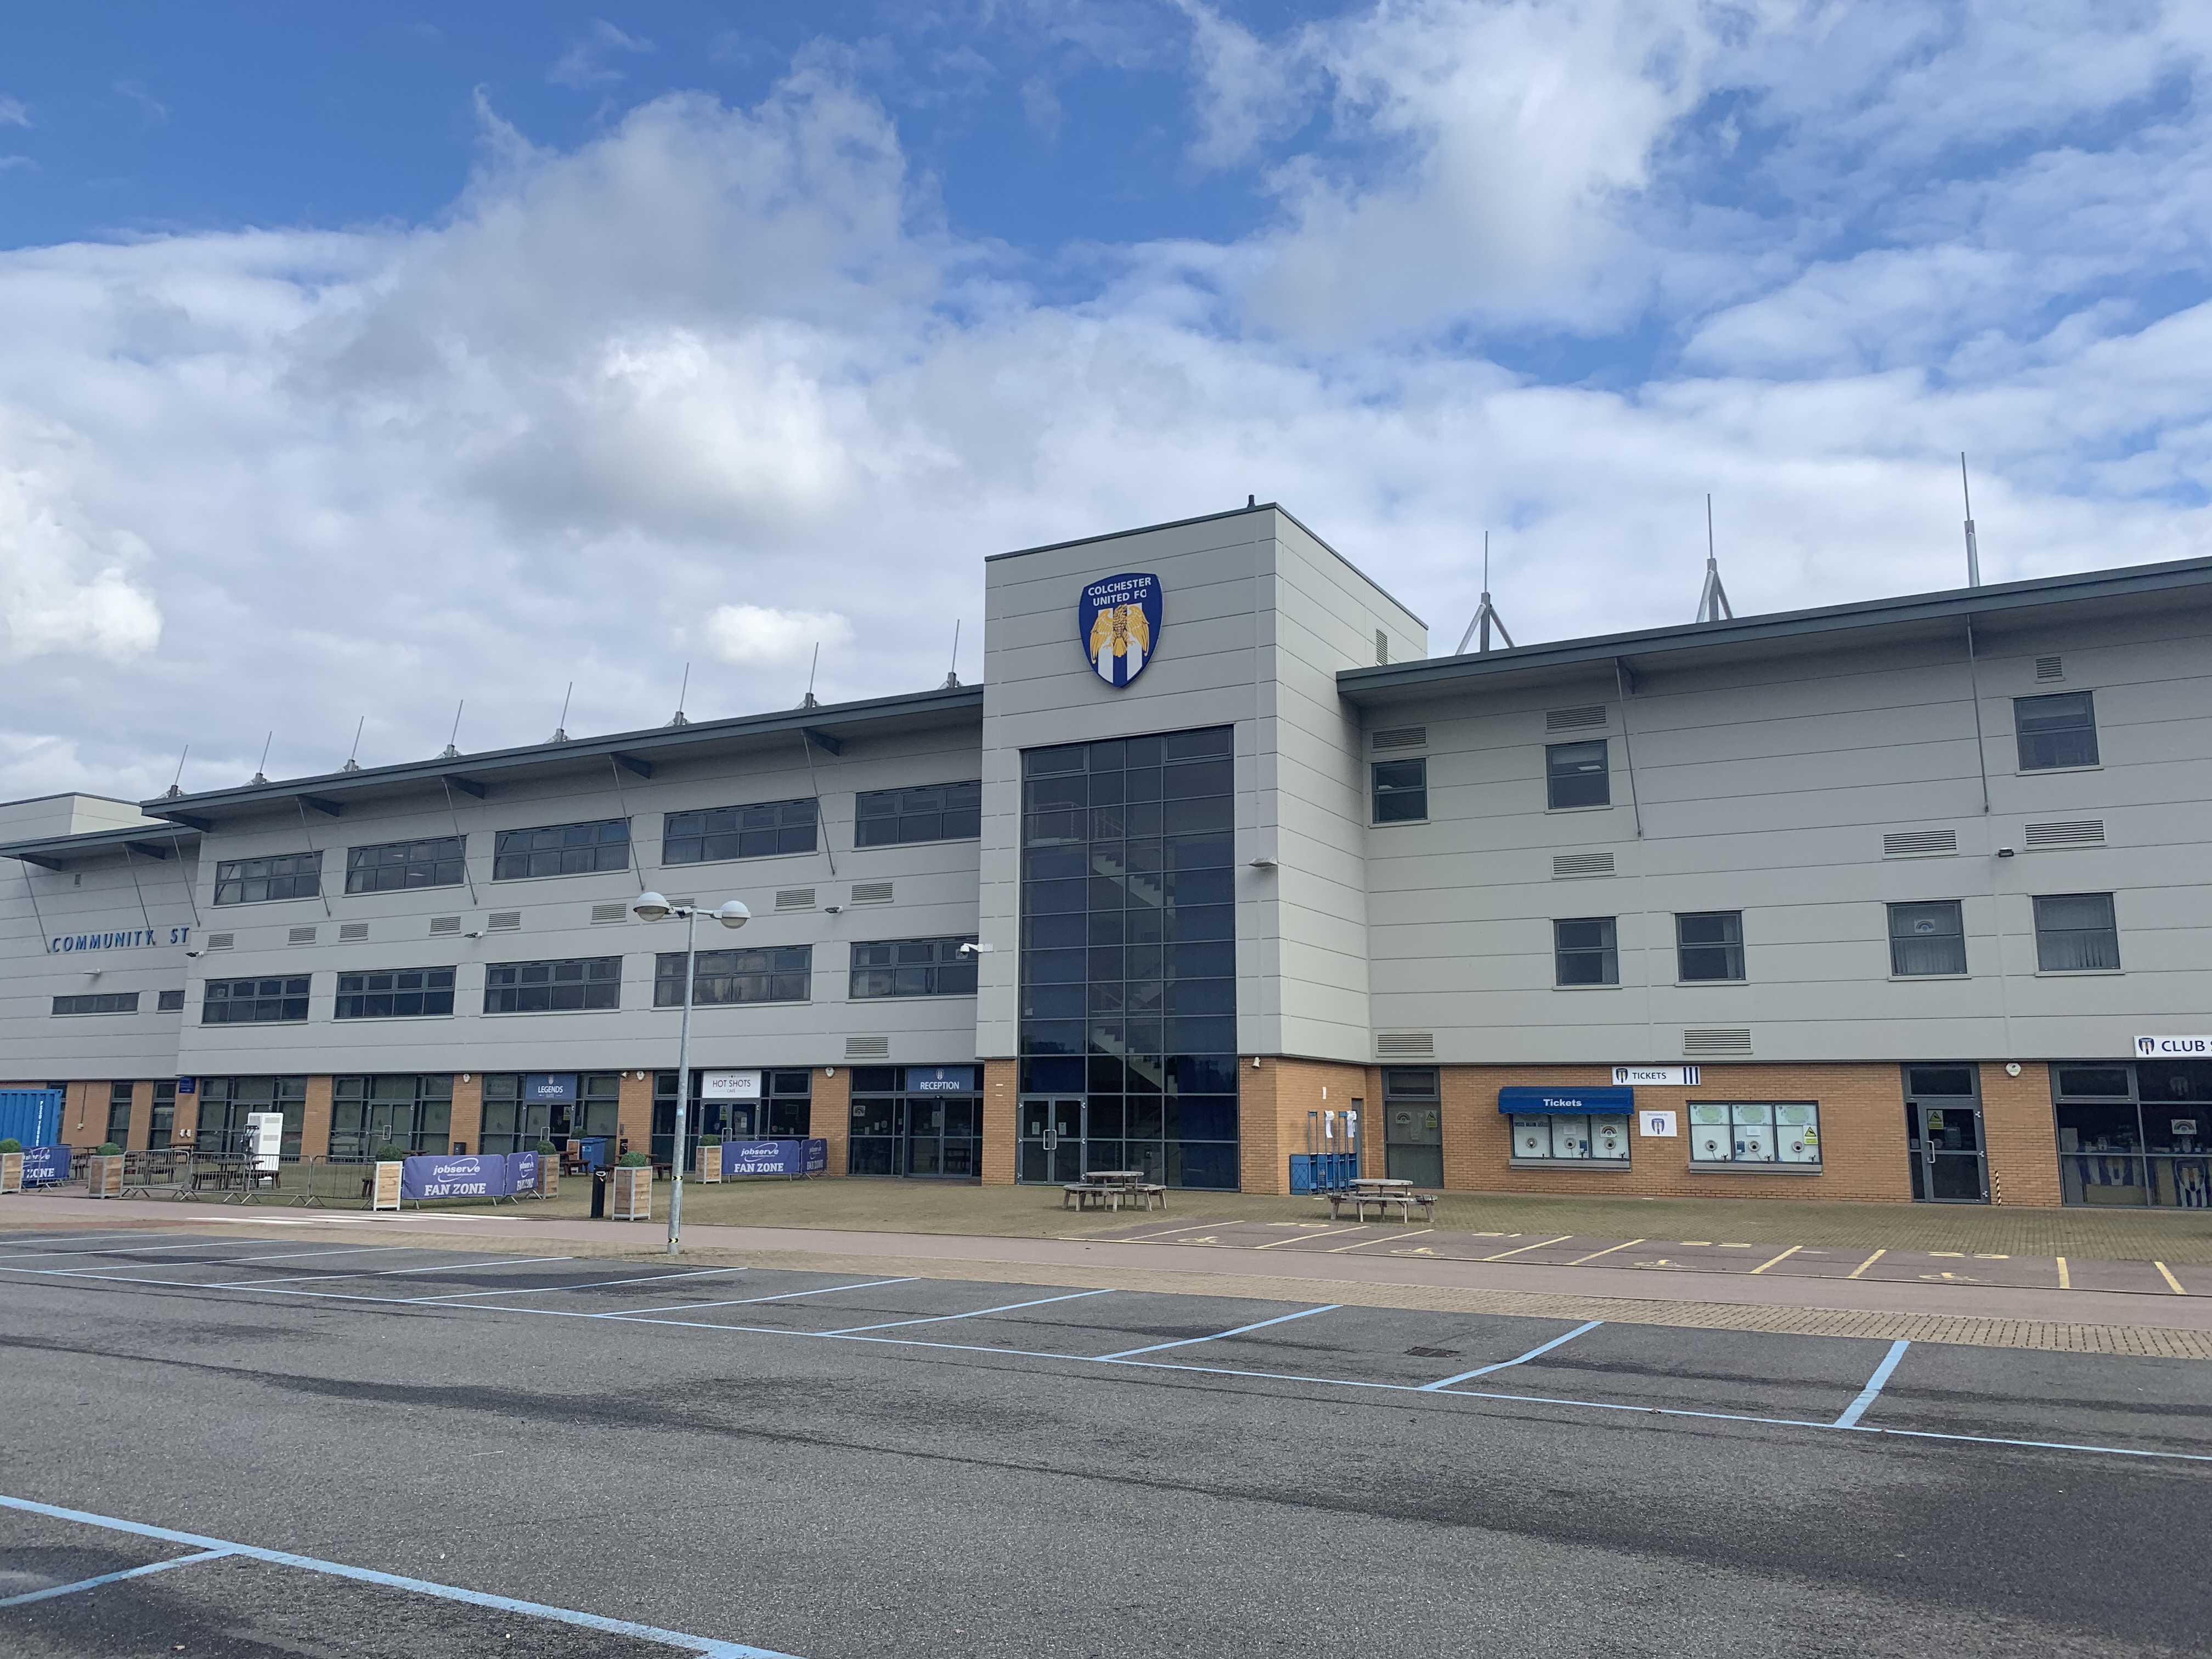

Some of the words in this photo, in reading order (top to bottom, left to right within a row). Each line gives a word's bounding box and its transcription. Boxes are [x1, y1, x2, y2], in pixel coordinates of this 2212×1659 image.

[1088, 577, 1152, 596] COLCHESTER
[1093, 592, 1130, 606] UNITED
[52, 930, 154, 953] COMMUNITY
[2162, 1040, 2205, 1052] CLUB
[1632, 1071, 1667, 1080] TICKETS
[729, 1079, 751, 1087] SHOTS
[920, 1081, 960, 1090] RECEPTION
[1543, 1098, 1582, 1107] Tickets
[741, 1148, 779, 1156] jobserve
[433, 1164, 481, 1176] jobserve
[734, 1164, 755, 1173] FAN
[757, 1163, 784, 1172] ZONE
[424, 1184, 450, 1196] FAN
[452, 1183, 487, 1195] ZONE
